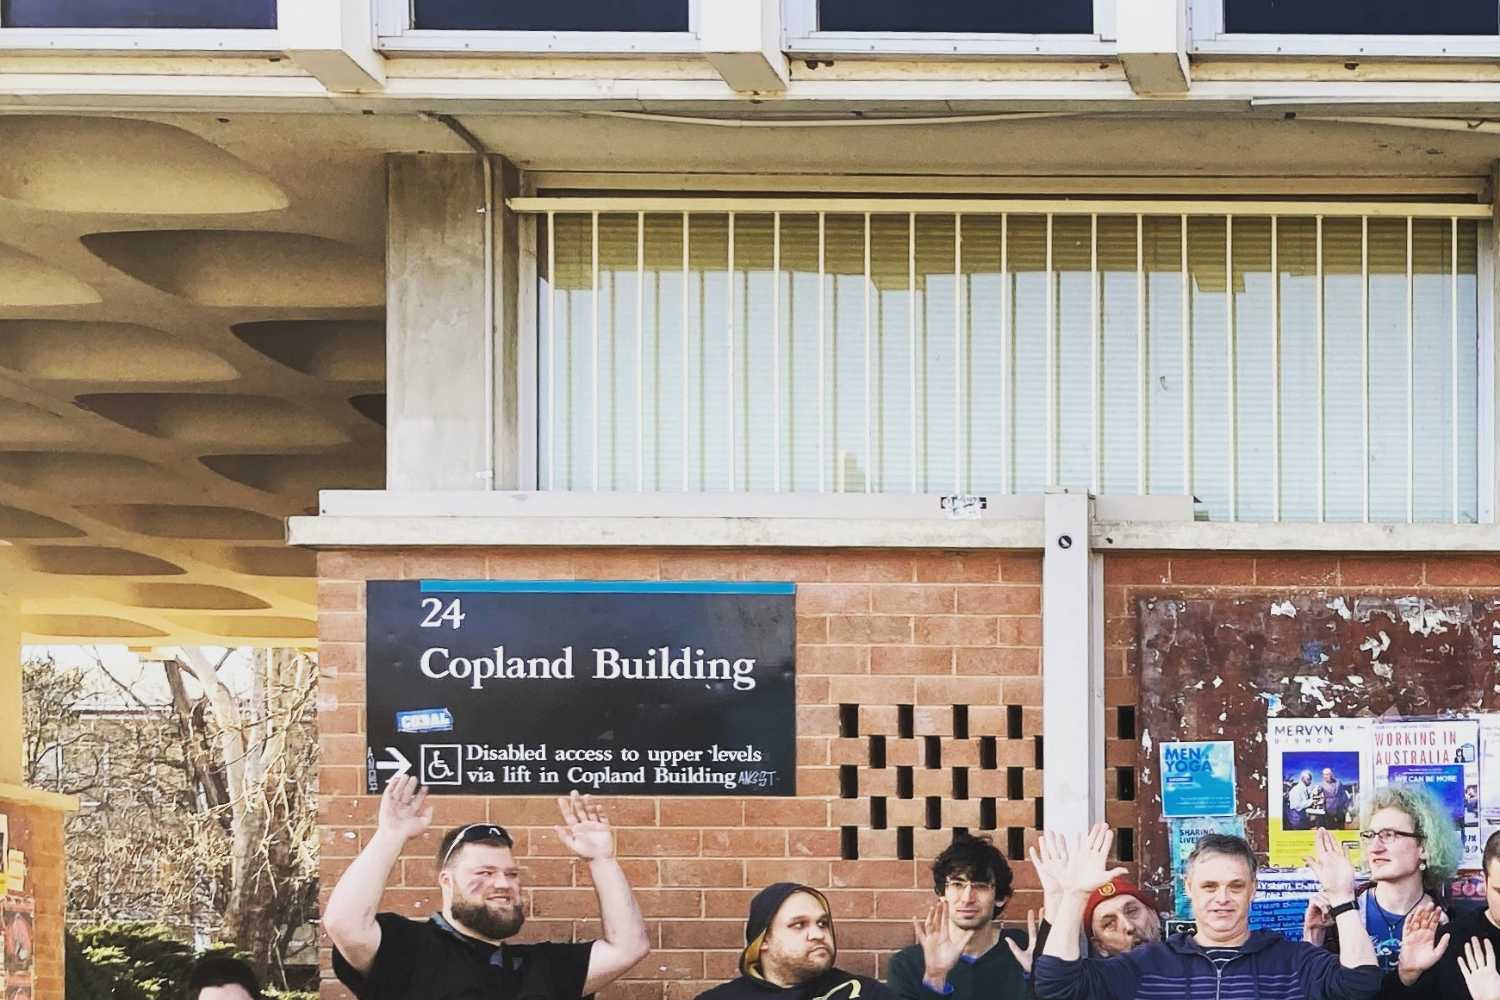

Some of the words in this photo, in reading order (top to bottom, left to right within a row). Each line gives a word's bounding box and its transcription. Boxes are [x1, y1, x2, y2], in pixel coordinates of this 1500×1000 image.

[420, 597, 465, 629] 24
[420, 645, 574, 689] Copland
[592, 646, 756, 690] Building
[1274, 725, 1333, 736] MERVYN
[1375, 731, 1436, 746] WORKING
[1443, 731, 1457, 745] IN
[465, 744, 547, 761] Disabled
[555, 749, 613, 761] access
[621, 748, 640, 761] to
[647, 749, 703, 766] upper
[711, 744, 762, 762] levels
[1165, 748, 1201, 760] MEN
[1376, 749, 1449, 765] AUSTRALIA
[1165, 760, 1212, 772] YOGA
[466, 766, 495, 783] via
[502, 765, 531, 783] lift
[539, 766, 559, 783] in
[567, 766, 645, 788] Copland
[653, 766, 737, 789] Building
[1408, 775, 1424, 783] CAN
